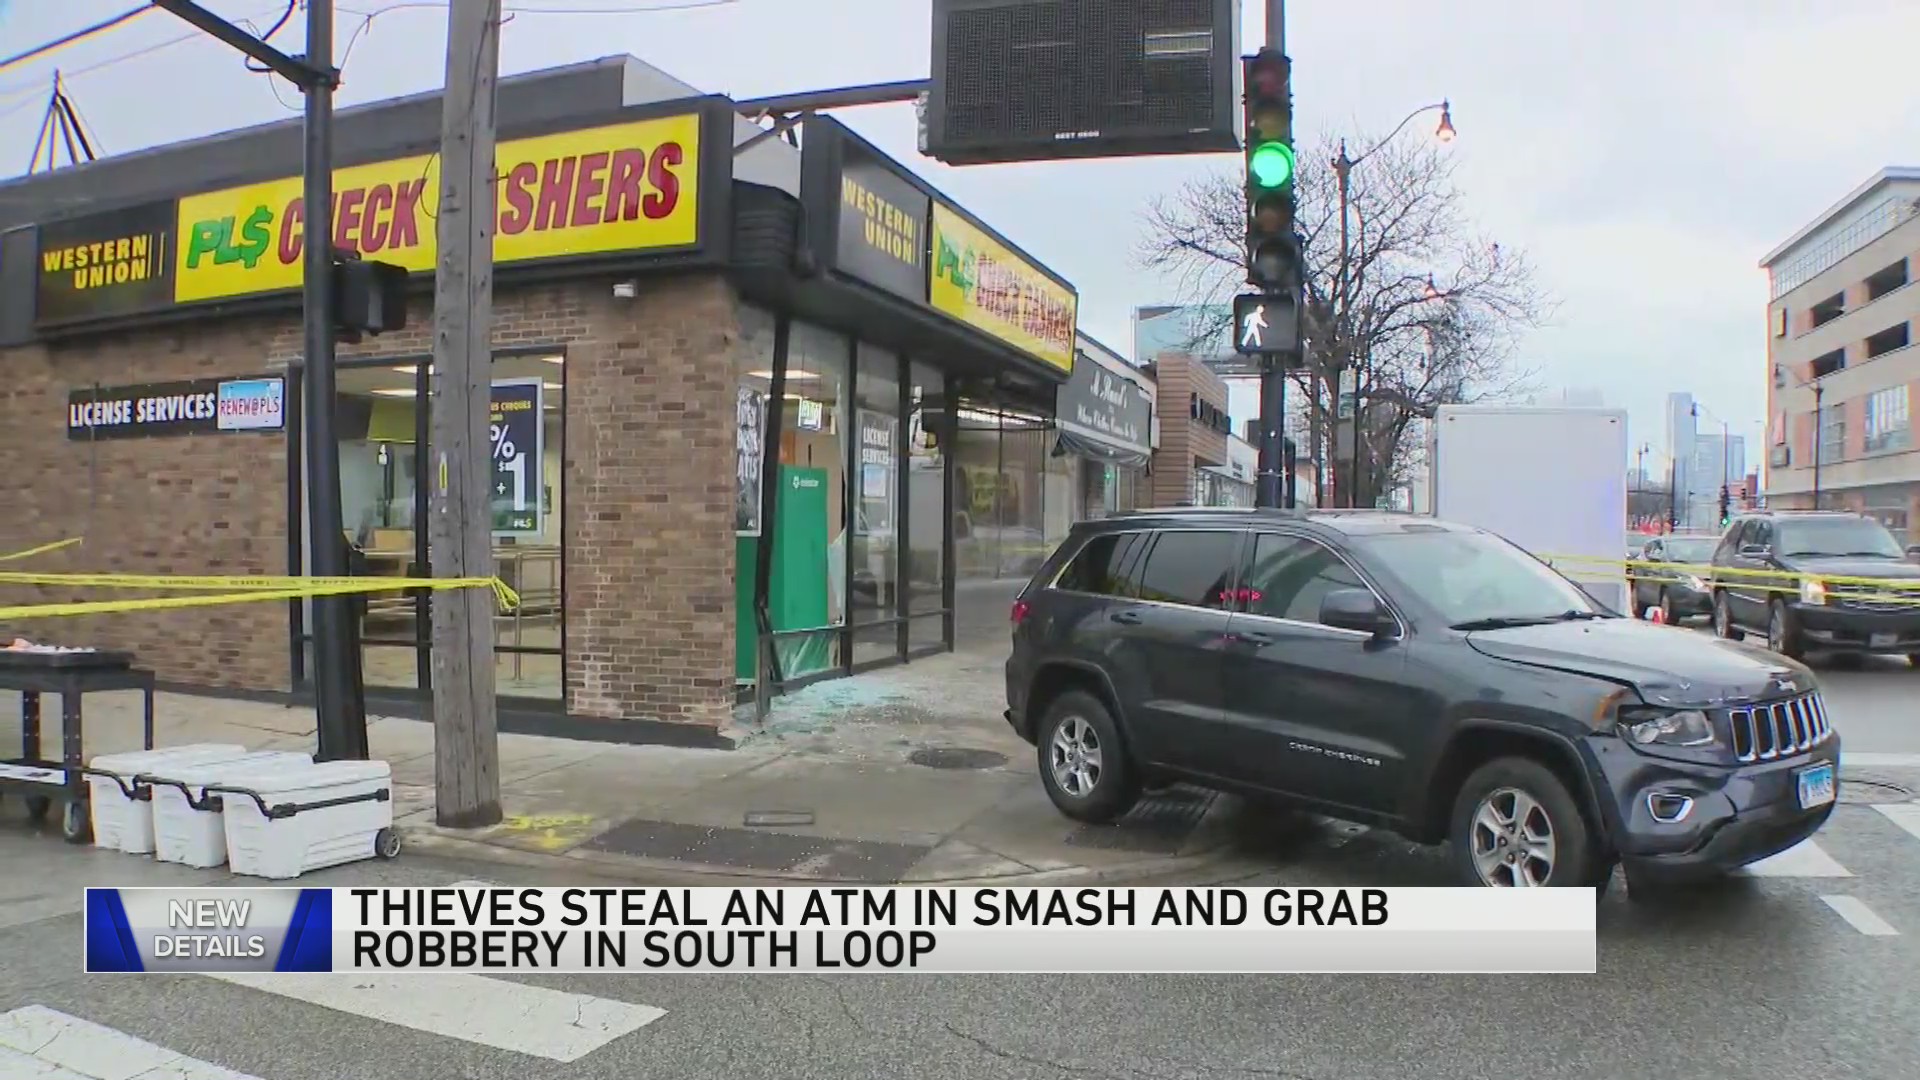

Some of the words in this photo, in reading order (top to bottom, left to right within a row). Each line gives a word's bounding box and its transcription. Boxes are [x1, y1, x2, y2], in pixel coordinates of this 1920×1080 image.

[277, 177, 427, 264] CECK
[842, 178, 914, 241] WESTERN
[44, 235, 147, 272] WESTERN
[864, 216, 913, 265] UNION
[75, 258, 145, 289] UNION
[70, 398, 132, 429] LICENSE
[135, 392, 216, 424] SERVICES
[219, 394, 281, 417] RENEW@PLS
[863, 426, 890, 447] LICENSE
